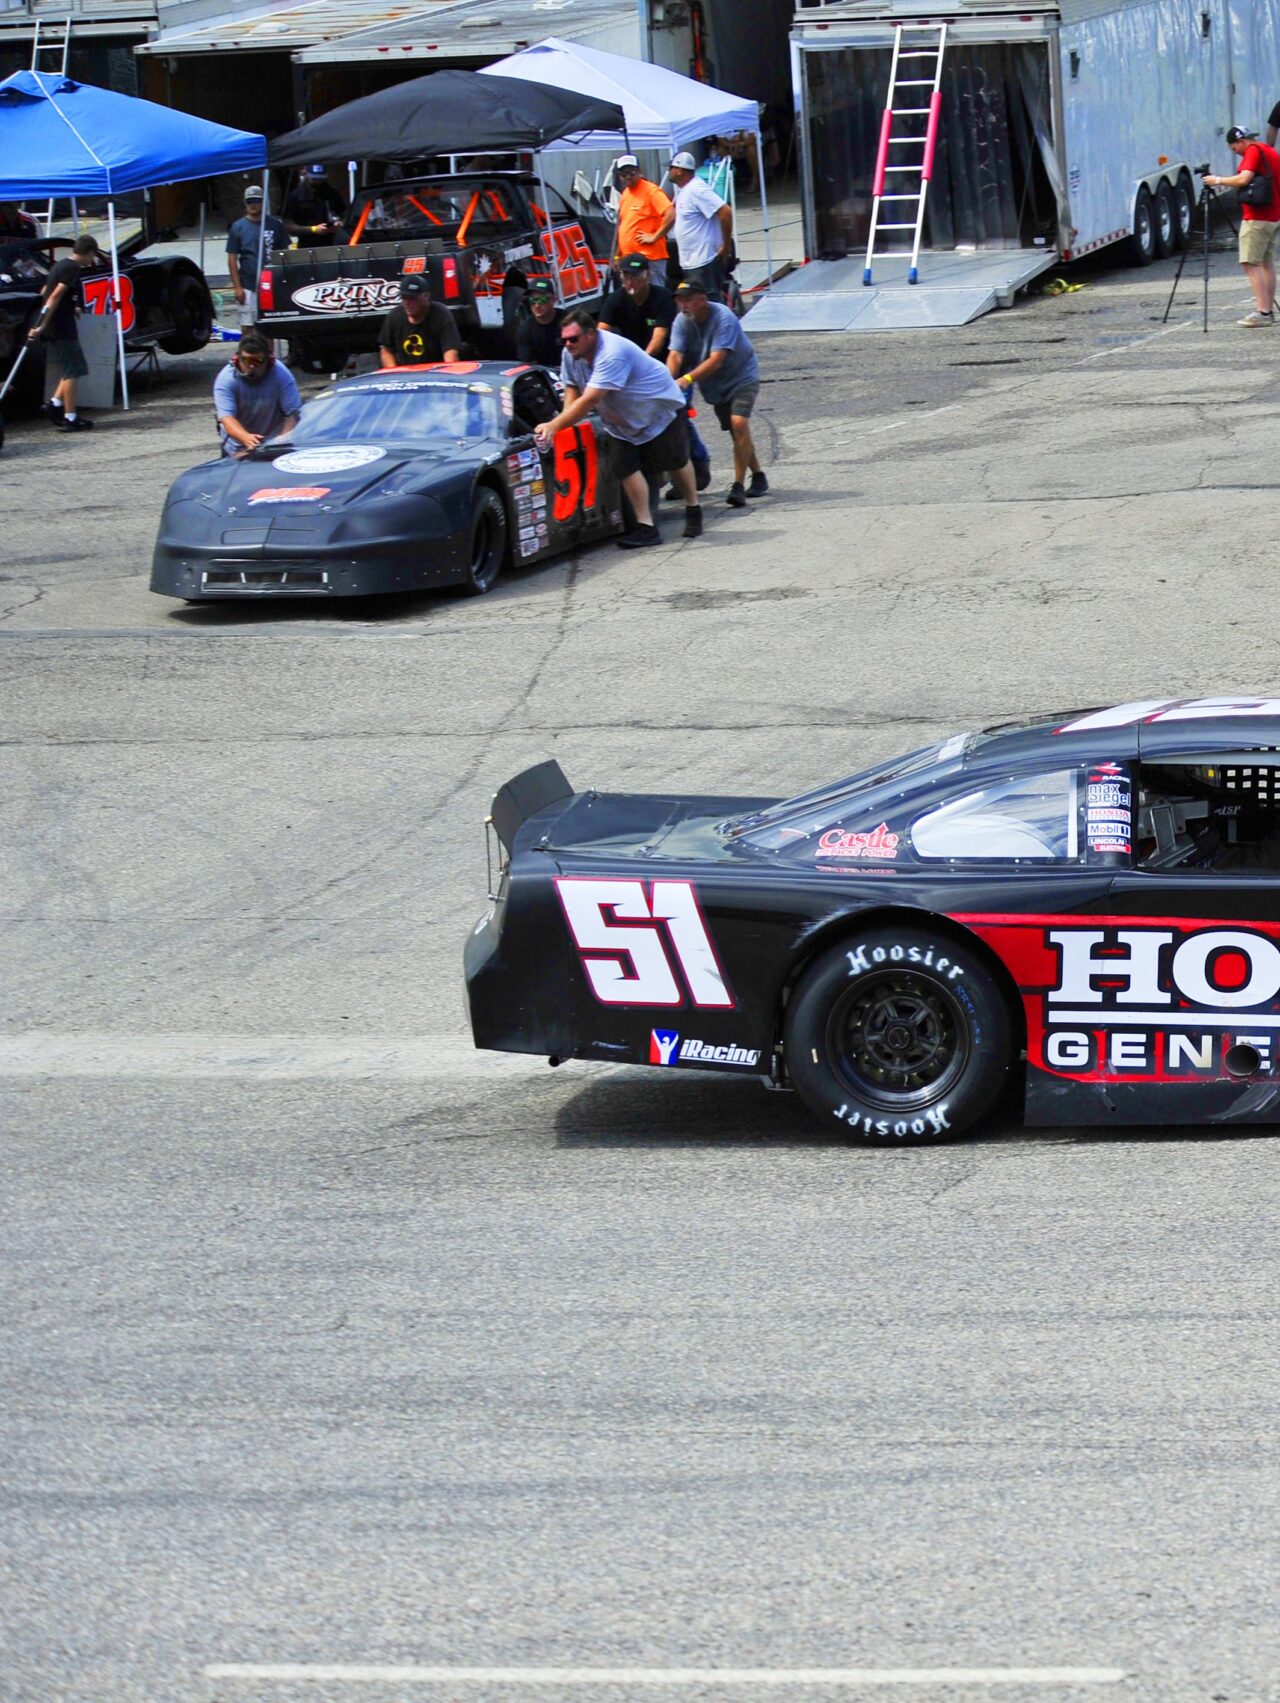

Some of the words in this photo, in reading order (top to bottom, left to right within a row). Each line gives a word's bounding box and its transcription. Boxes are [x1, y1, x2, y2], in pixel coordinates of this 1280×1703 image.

[314, 283, 402, 302] PRINC
[553, 419, 599, 521] 51
[1088, 783, 1120, 795] max
[819, 822, 898, 849] Castle
[1090, 824, 1119, 834] Mobil
[1091, 837, 1125, 846] LINCOLN
[554, 877, 735, 1008] 51
[846, 945, 964, 979] Hoosier
[679, 1039, 762, 1066] iRacing
[833, 1104, 951, 1137] Hoosier
